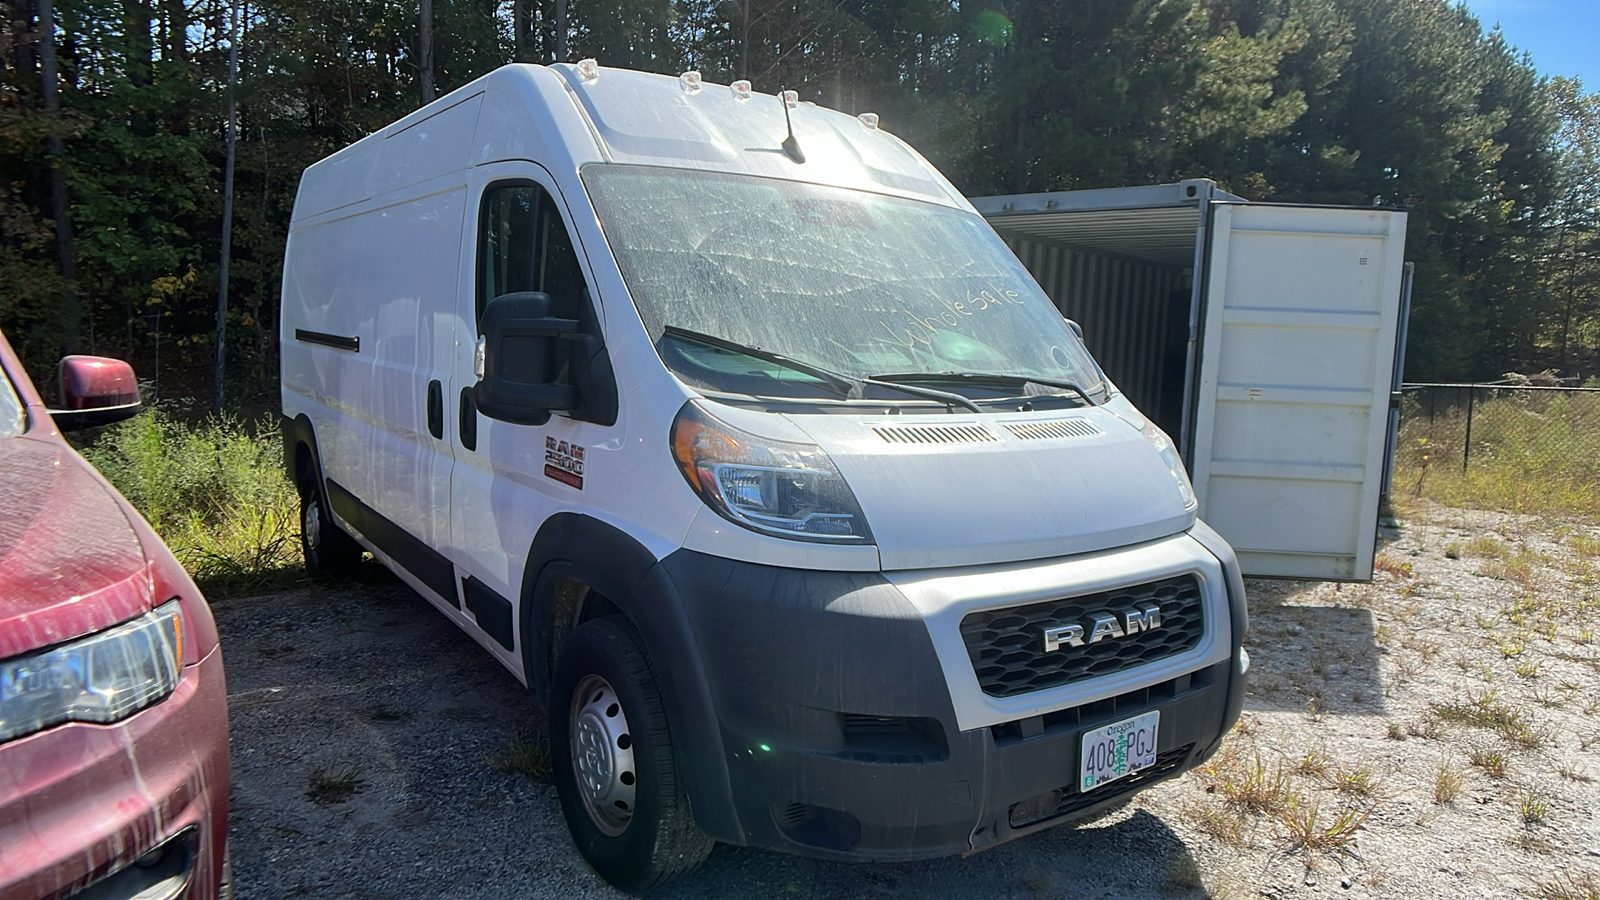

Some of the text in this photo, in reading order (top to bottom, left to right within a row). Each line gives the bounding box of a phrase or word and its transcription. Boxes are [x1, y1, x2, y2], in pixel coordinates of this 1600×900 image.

[545, 435, 586, 460] RAM
[1044, 605, 1161, 653] RAM
[1107, 720, 1136, 736] Oregon
[1086, 724, 1156, 775] 408 PGJ
